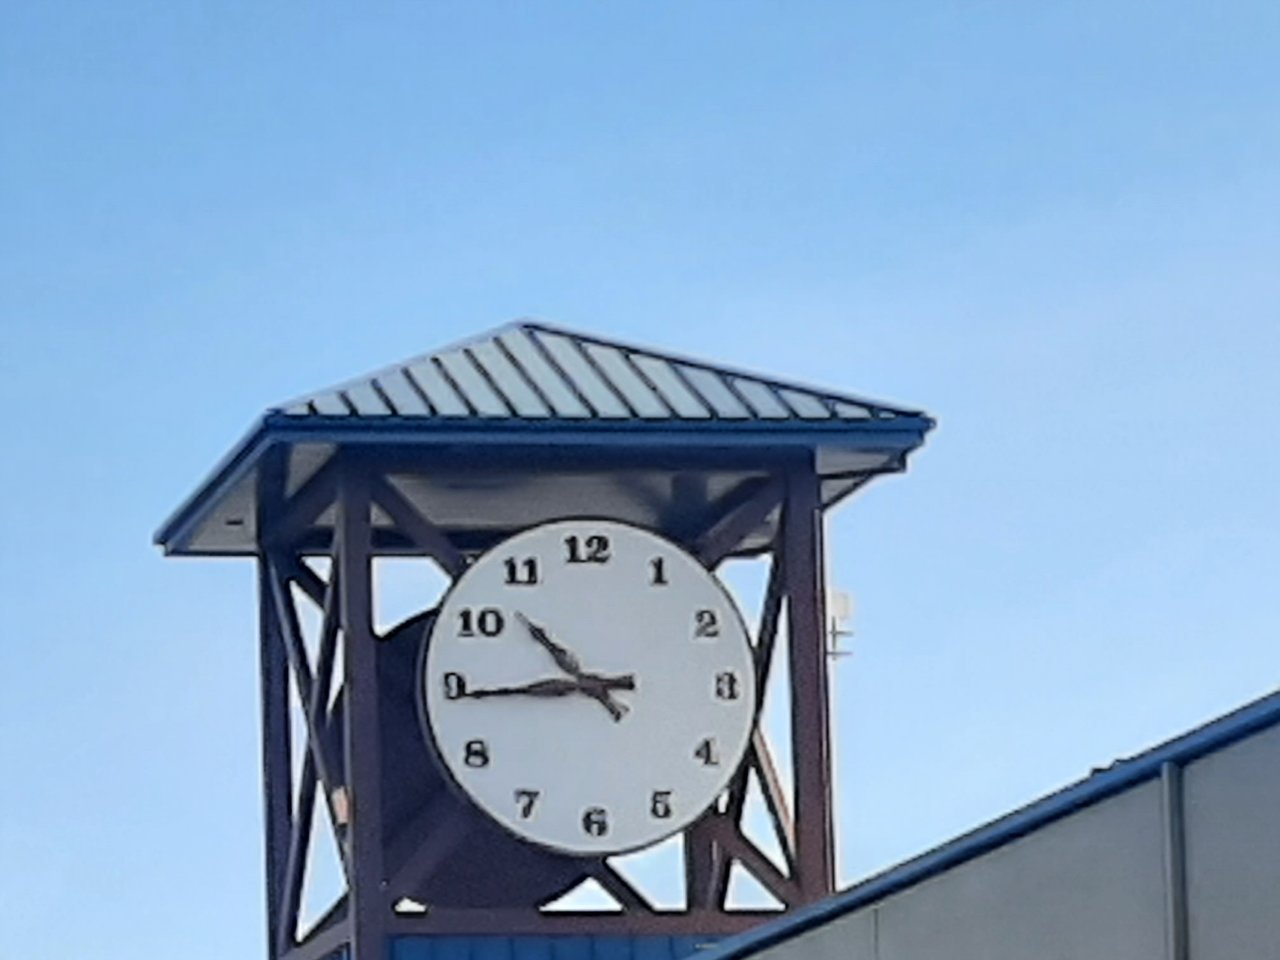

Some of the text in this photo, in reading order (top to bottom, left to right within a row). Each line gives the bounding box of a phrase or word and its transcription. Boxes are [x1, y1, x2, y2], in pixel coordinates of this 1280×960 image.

[565, 536, 611, 563] 12
[504, 558, 539, 585] 11
[651, 558, 669, 585] 1
[459, 609, 504, 637] 10
[694, 610, 719, 637] 2
[444, 673, 466, 699] 9
[716, 673, 738, 699] 3
[464, 740, 489, 767] 8
[694, 738, 719, 765] 4
[516, 791, 539, 818] 7
[651, 792, 671, 818] 5
[582, 809, 607, 836] 6
